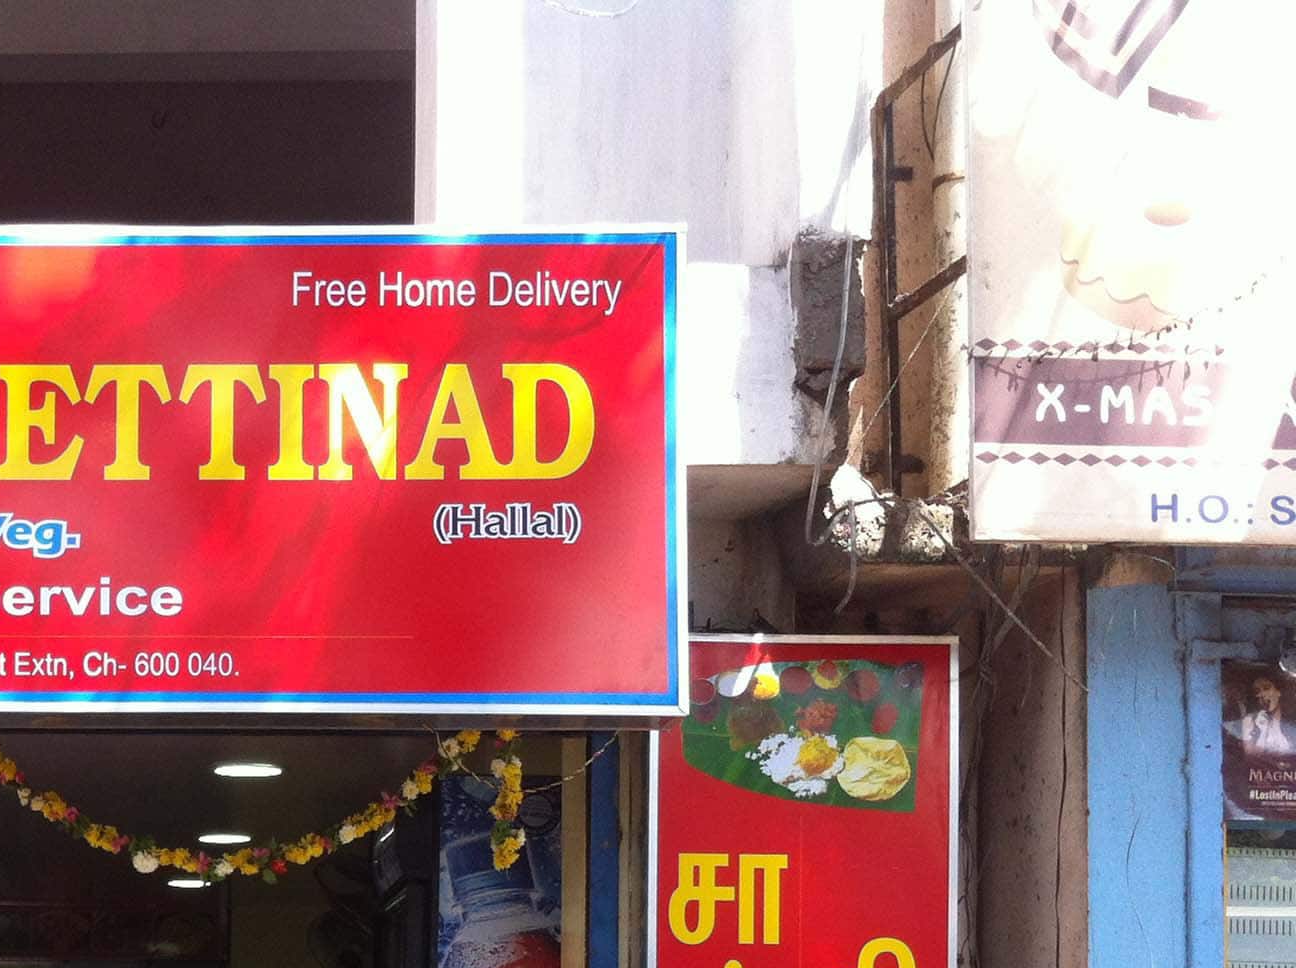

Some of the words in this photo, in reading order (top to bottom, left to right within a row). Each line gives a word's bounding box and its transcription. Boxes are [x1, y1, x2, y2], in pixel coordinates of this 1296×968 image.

[291, 271, 366, 307] Free
[379, 271, 476, 307] Home
[489, 271, 622, 316] Delivery
[1034, 382, 1213, 426] X-MAS
[433, 502, 582, 544] (Hallal)
[14, 652, 75, 680] Extn,
[83, 653, 127, 677] Ch-
[134, 653, 180, 677] 600
[188, 653, 240, 677] 040.
